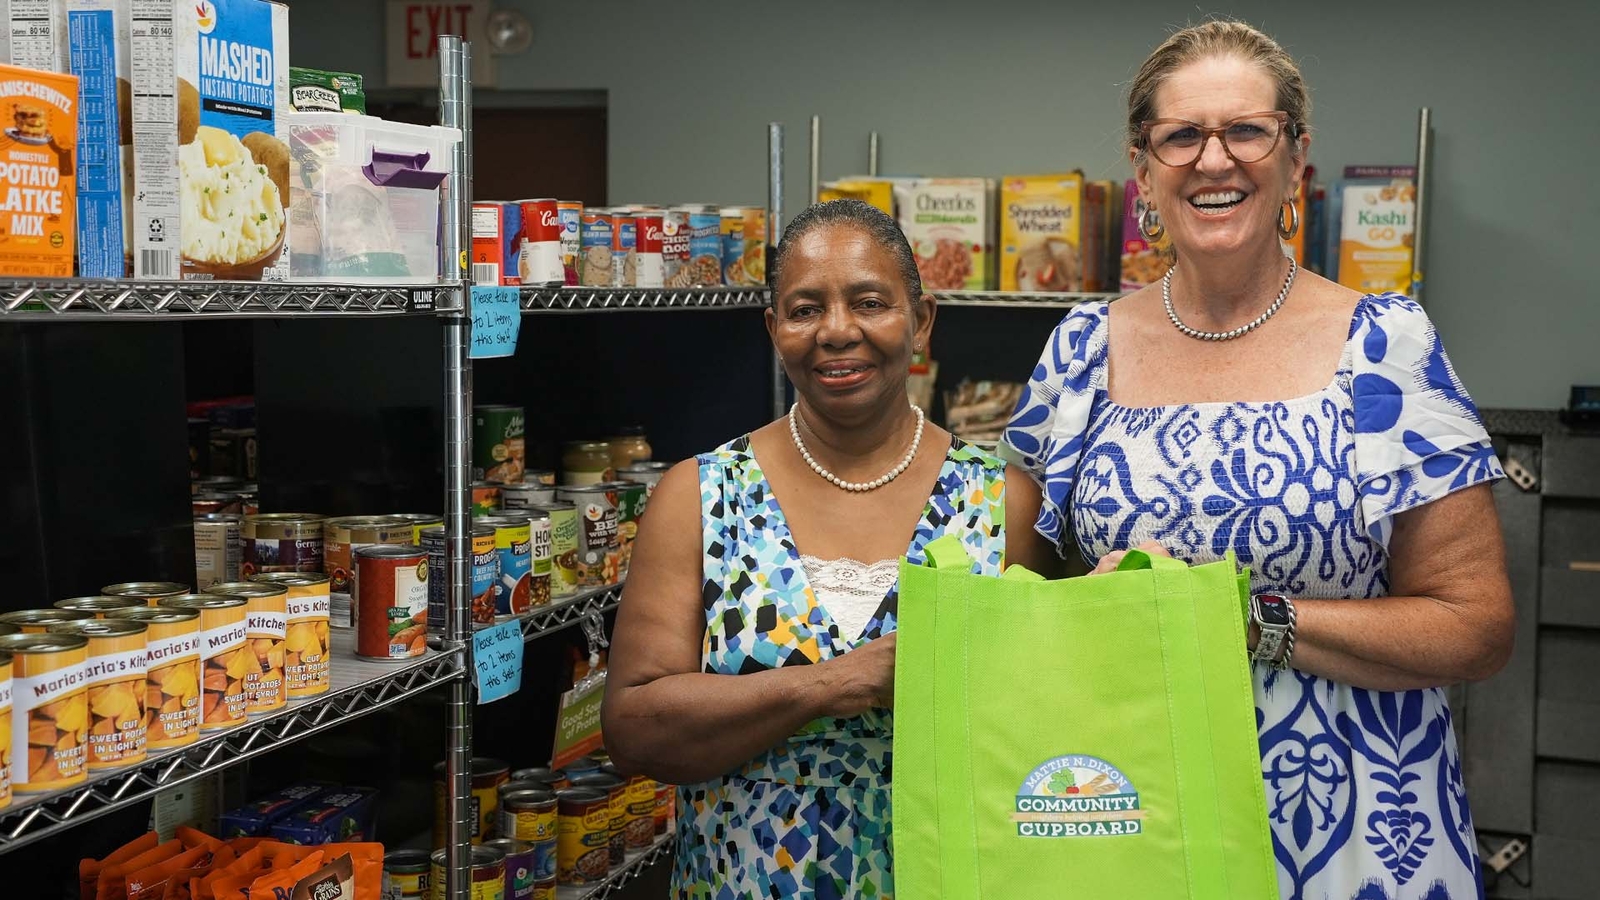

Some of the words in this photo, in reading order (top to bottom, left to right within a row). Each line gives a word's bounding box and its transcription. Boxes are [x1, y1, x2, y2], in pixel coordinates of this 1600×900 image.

[406, 4, 473, 58] EXIT
[201, 36, 272, 86] MASHED
[202, 76, 236, 100] INSTANT
[238, 83, 272, 106] POTATOES
[0, 162, 59, 188] POTATO
[1008, 204, 1072, 218] Shredded
[1358, 210, 1406, 226] Kashi
[11, 214, 44, 236] MIX
[1018, 219, 1062, 232] Wheat
[1368, 227, 1396, 241] GO
[414, 291, 432, 303] ULINE
[472, 291, 493, 306] Please
[511, 293, 519, 305] up
[473, 316, 484, 330] to
[494, 312, 513, 327] items
[475, 334, 493, 346] this
[288, 603, 309, 614] ia's
[248, 617, 285, 630] Kitchen
[208, 627, 246, 649] Maria's
[475, 636, 495, 652] Please
[512, 629, 520, 640] up
[87, 660, 126, 677] aria's
[478, 660, 488, 672] to
[488, 654, 497, 669] 2
[498, 650, 516, 662] items
[34, 670, 84, 697] Maria's
[295, 673, 316, 681] LIGHT
[486, 675, 500, 688] this
[503, 666, 515, 682] shelf
[256, 690, 279, 699] SYRUP
[160, 711, 187, 722] SWEET
[176, 718, 195, 728] LIGHT
[562, 707, 584, 729] Good
[123, 720, 138, 730] CUT
[566, 724, 575, 740] of
[89, 732, 122, 743] SWEET
[54, 746, 82, 760] SWEET
[94, 745, 105, 753] IN
[109, 741, 134, 752] LIGHT
[58, 760, 68, 770] IN
[1026, 758, 1070, 789] MATTIE
[1073, 757, 1086, 767] N.
[1087, 759, 1128, 787] DIXON
[1018, 796, 1137, 812] COMMUNITY
[1020, 820, 1139, 836] CUPBOARD
[314, 884, 340, 900] GRAINS
